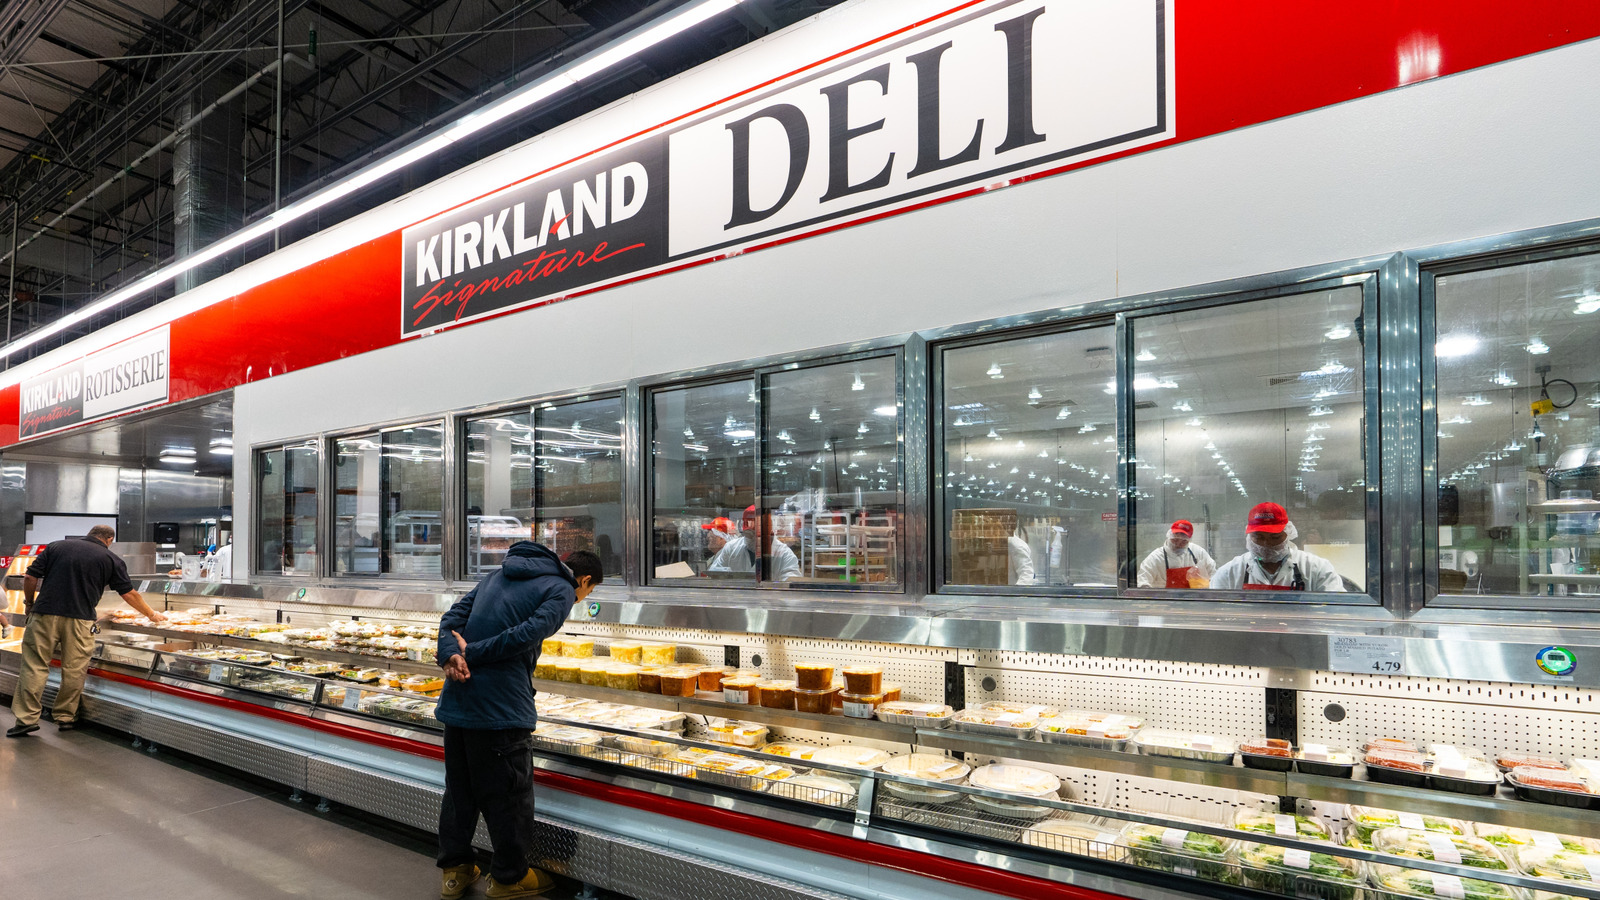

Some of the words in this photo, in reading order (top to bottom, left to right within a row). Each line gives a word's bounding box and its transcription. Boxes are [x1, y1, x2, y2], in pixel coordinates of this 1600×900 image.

[724, 6, 1046, 231] DELI
[416, 160, 650, 287] KIRKLAND
[413, 240, 646, 325] Signature
[23, 371, 81, 414] KIRKLAND
[85, 349, 165, 402] ROTISSERIE
[22, 406, 79, 435] Signature
[1372, 661, 1401, 671] 4.79
